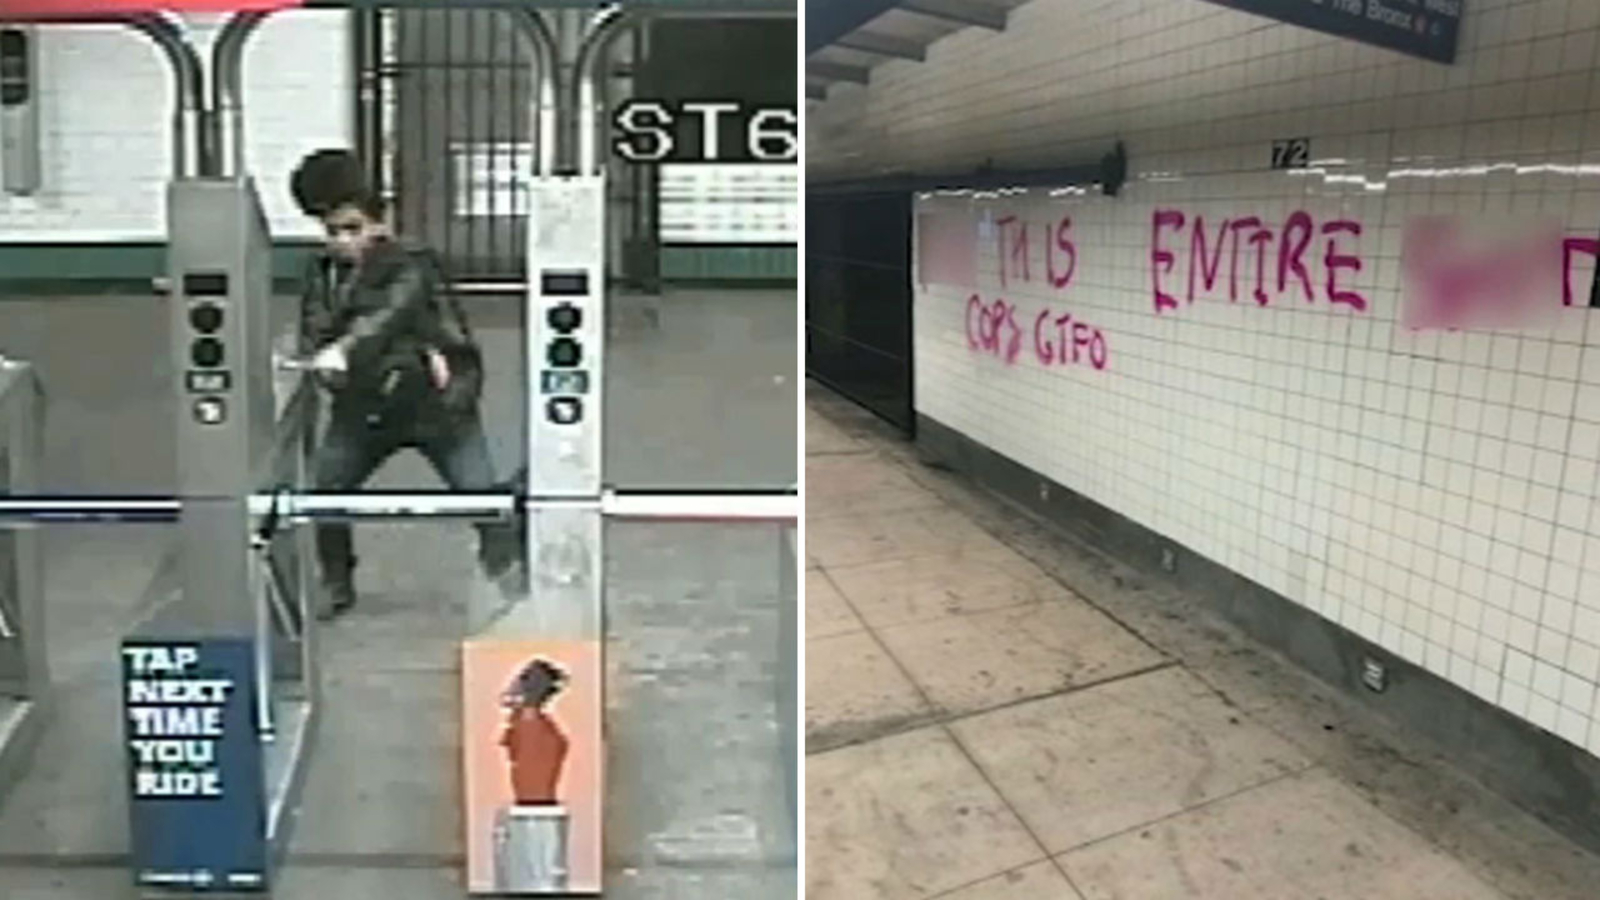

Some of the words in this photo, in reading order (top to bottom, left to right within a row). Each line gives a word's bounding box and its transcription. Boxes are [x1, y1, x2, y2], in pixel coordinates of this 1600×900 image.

[1366, 0, 1412, 29] Bronx
[1272, 140, 1308, 167] 72
[1152, 210, 1366, 313] ENTIRE
[965, 295, 1021, 365] COPS
[1034, 309, 1107, 370] GTFO
[122, 646, 199, 670] TAP
[128, 680, 235, 703] NEXT
[129, 707, 224, 735] TIME
[130, 740, 215, 763] YOU
[136, 773, 224, 796] RIDE
